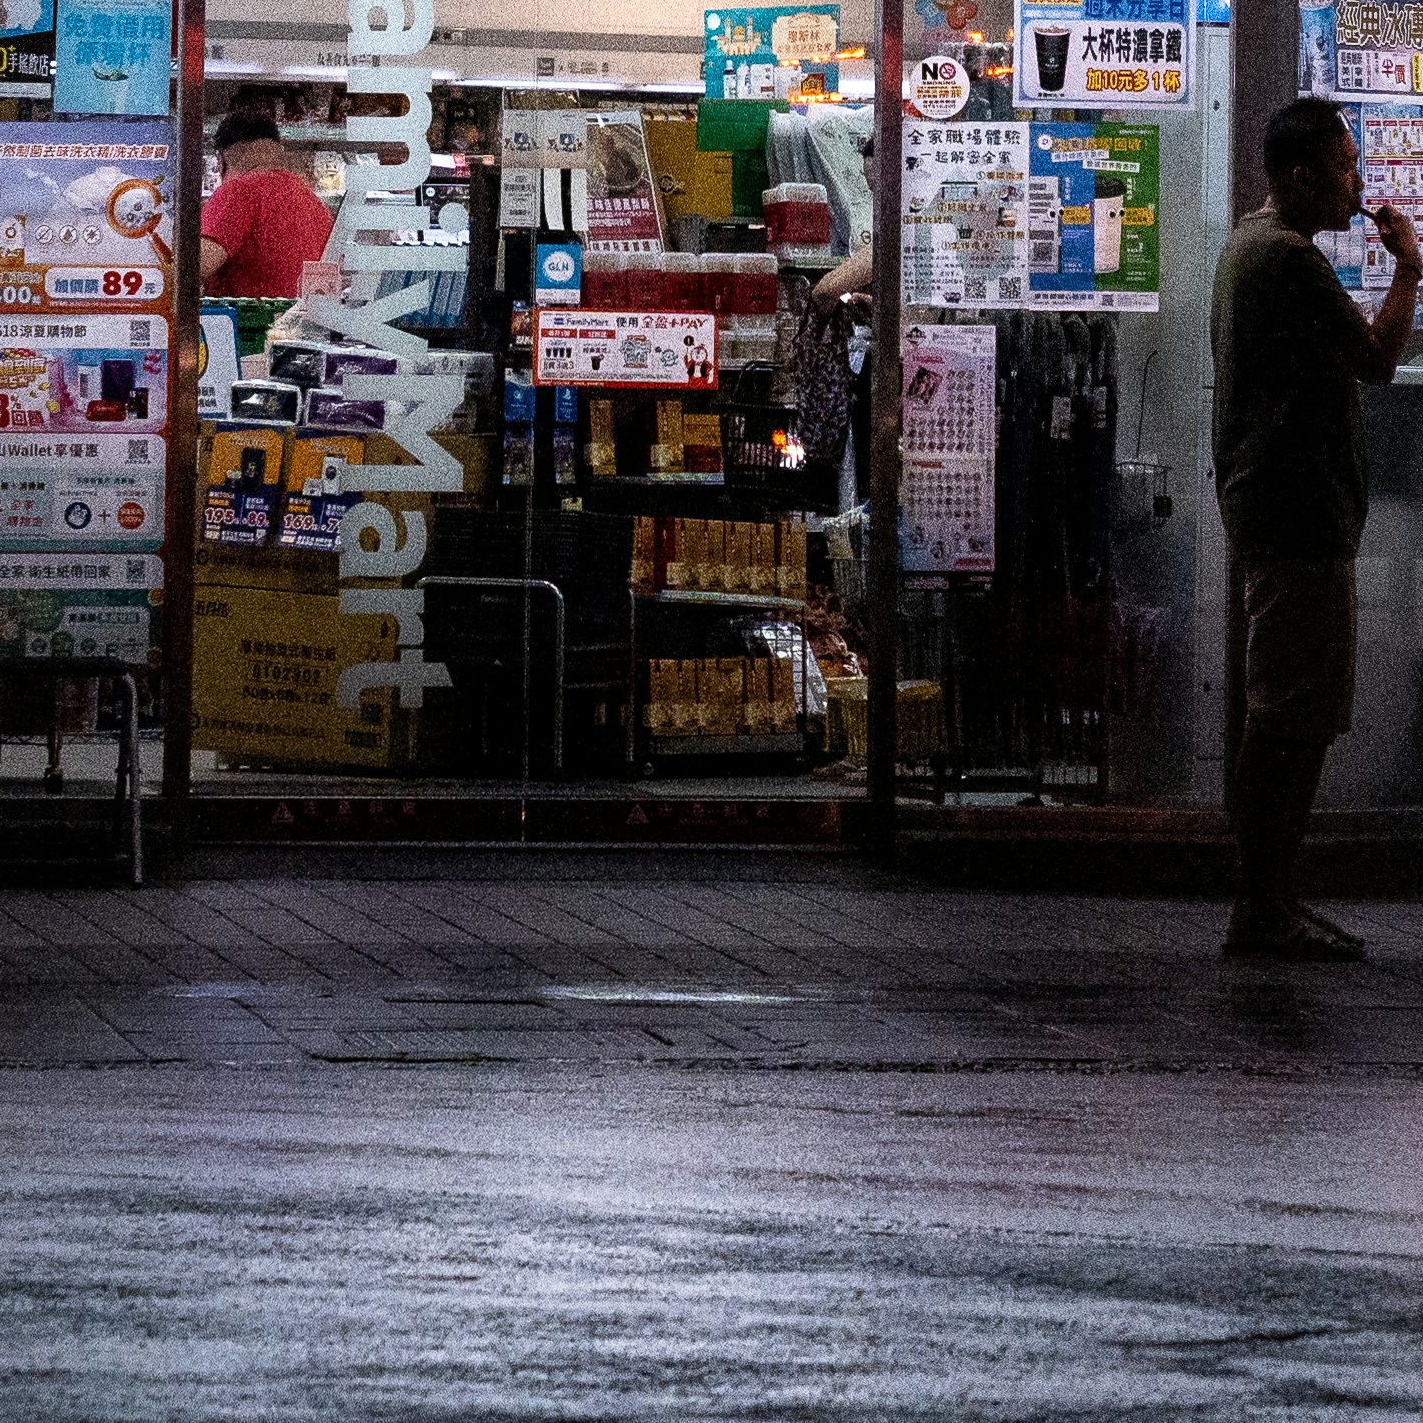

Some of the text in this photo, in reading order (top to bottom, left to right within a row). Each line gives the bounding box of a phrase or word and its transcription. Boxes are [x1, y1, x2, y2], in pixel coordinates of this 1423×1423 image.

[1081, 26, 1183, 64] 大杯特濃拿鐵
[907, 129, 1022, 146] 全家職場體驗
[920, 150, 1012, 165] 一起解密全家
[615, 317, 639, 329] 使用
